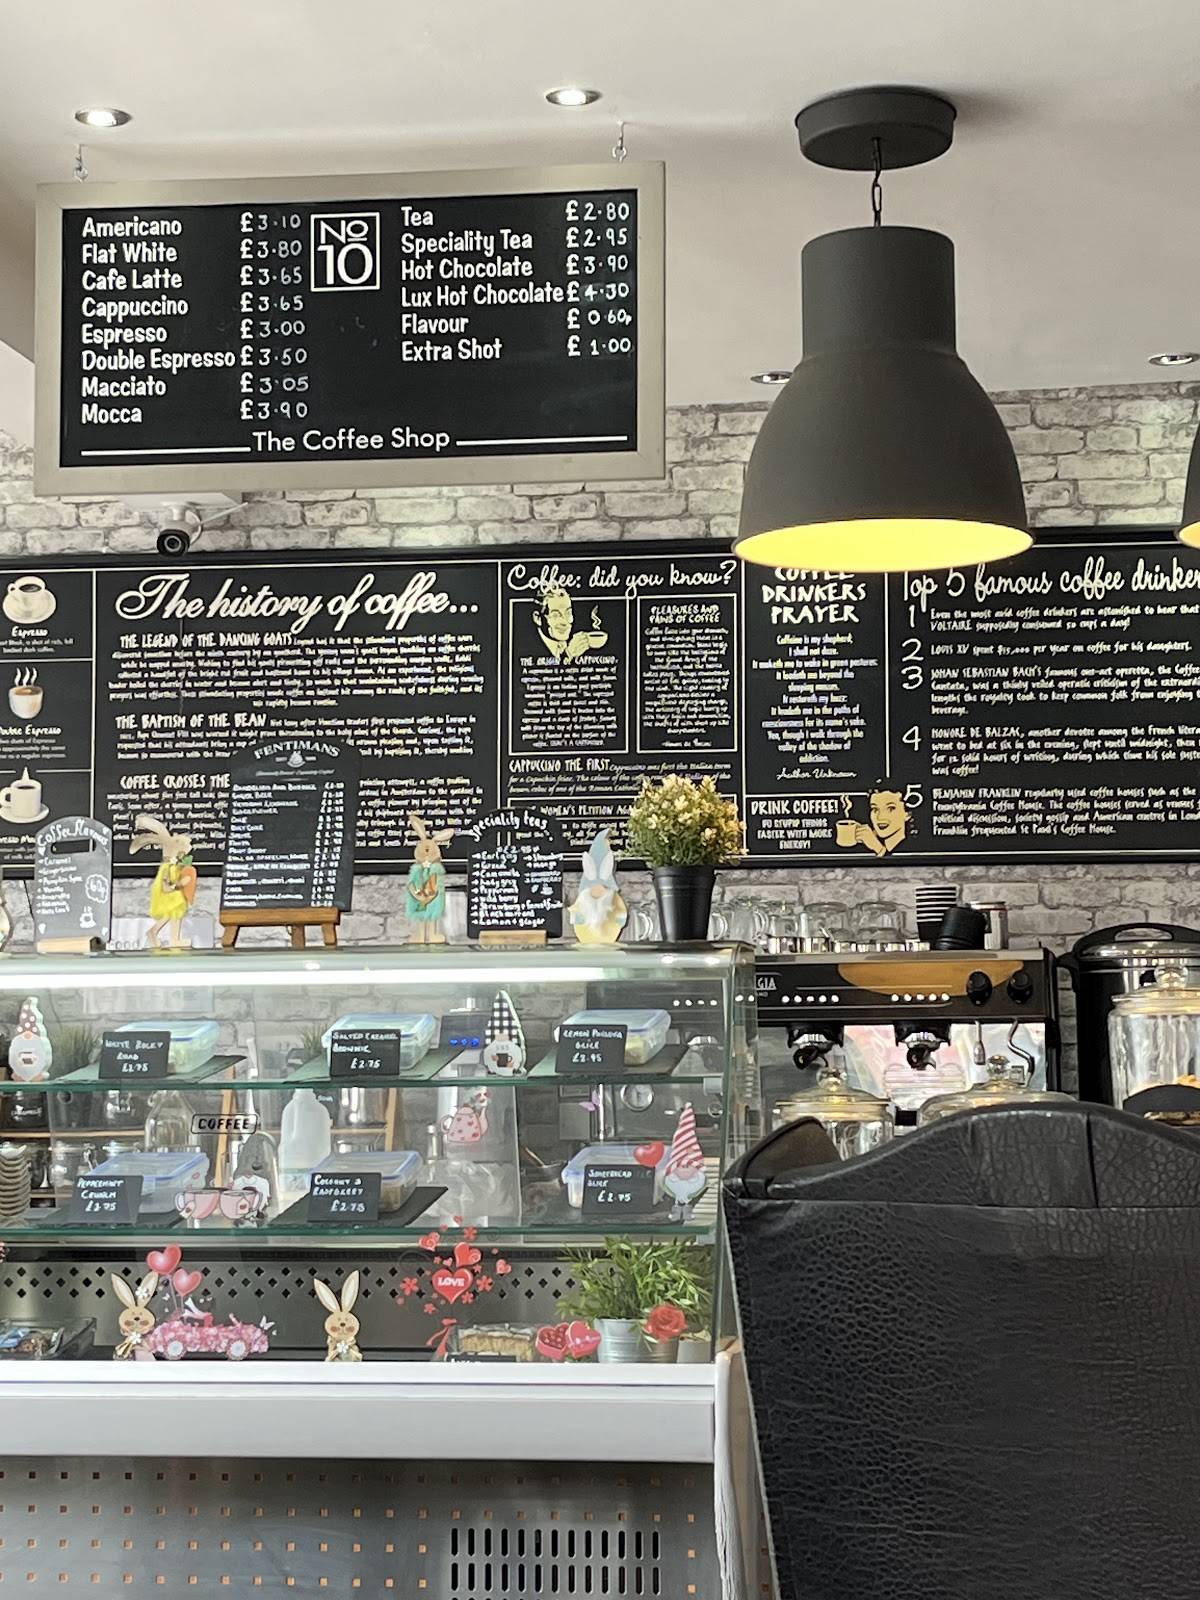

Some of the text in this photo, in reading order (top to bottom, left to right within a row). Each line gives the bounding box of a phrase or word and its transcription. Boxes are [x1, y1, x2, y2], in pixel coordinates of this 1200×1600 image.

[401, 206, 433, 226] Tea
[566, 200, 629, 221] £2.80
[82, 216, 181, 237] Americano
[241, 212, 300, 232] £3.10
[401, 229, 532, 259] Speciality Tea
[566, 227, 627, 248] £2.95
[83, 241, 177, 264] Flat White
[240, 239, 302, 259] £3.80
[318, 241, 373, 284] 10
[402, 255, 533, 280] Hot Chocolate
[566, 254, 628, 275] £3.90
[82, 268, 182, 290] Cafe Latte
[240, 265, 302, 285] £3.65
[240, 292, 303, 312] £3.65
[402, 282, 564, 307] Lux Hot Chocolate
[82, 295, 188, 323] Cappuccino
[240, 319, 305, 339] £3.00
[402, 313, 469, 334] Flavour
[82, 322, 167, 350] Espresso
[240, 345, 307, 366] £3.50
[402, 338, 502, 361] Extra Shot
[82, 348, 235, 374] Double Espresso
[82, 376, 166, 397] Macciato
[240, 372, 308, 393] £3.05
[82, 403, 142, 424] Mocca
[240, 399, 307, 419] £3.90
[252, 427, 449, 451] The Coffee Shop
[589, 565, 620, 587] did
[624, 574, 664, 599] you
[670, 560, 737, 586] know?
[974, 562, 1052, 602] famous
[1060, 556, 1125, 600] coffee
[762, 583, 866, 603] DRINKERS
[116, 573, 205, 619] The
[204, 579, 323, 636] history
[327, 574, 376, 631] of
[651, 604, 720, 615] PLEASURES AND
[771, 604, 859, 624] PRAYER
[676, 615, 686, 623] OF
[688, 613, 720, 623] COFFEE
[909, 605, 915, 627] 1
[931, 620, 972, 631] VOLTAIRE
[120, 634, 139, 648] THE
[142, 633, 178, 648] LEGEND
[181, 633, 194, 647] OF
[197, 632, 216, 647] THE
[219, 633, 260, 646] DANCING
[264, 631, 292, 645] GOATS
[931, 645, 953, 655] LOUIS
[957, 644, 969, 653] XV
[973, 646, 994, 656] spent
[1050, 645, 1070, 656] year
[1087, 642, 1111, 654] coffee
[1114, 641, 1129, 654] for
[1131, 641, 1144, 652] his
[902, 639, 923, 661] 2
[520, 657, 533, 666] THE
[901, 666, 923, 689] 3
[963, 667, 1009, 678] SEBASTIAN
[115, 713, 266, 729] THE BAPTISM OF THE BEAN
[902, 726, 921, 751] 4
[970, 727, 982, 738] DE
[253, 740, 342, 760] FENTIMANS
[509, 758, 610, 772] CAPPUCCINO THE FIRST
[120, 774, 230, 789] COFFEE CROSSES THE
[904, 784, 923, 808] 5
[933, 788, 1021, 799] BENJAMIN FRANKLIN
[579, 805, 613, 815] PETITION
[751, 799, 838, 815] DRINK COFFEE!
[524, 809, 548, 829] teas
[774, 819, 800, 828] STUPID
[802, 818, 827, 827] THINGS
[36, 824, 71, 847] Coffee
[758, 829, 832, 839] FASTER WITH MORE
[198, 1118, 248, 1130] COFFEE
[438, 1277, 464, 1286] LOVE
